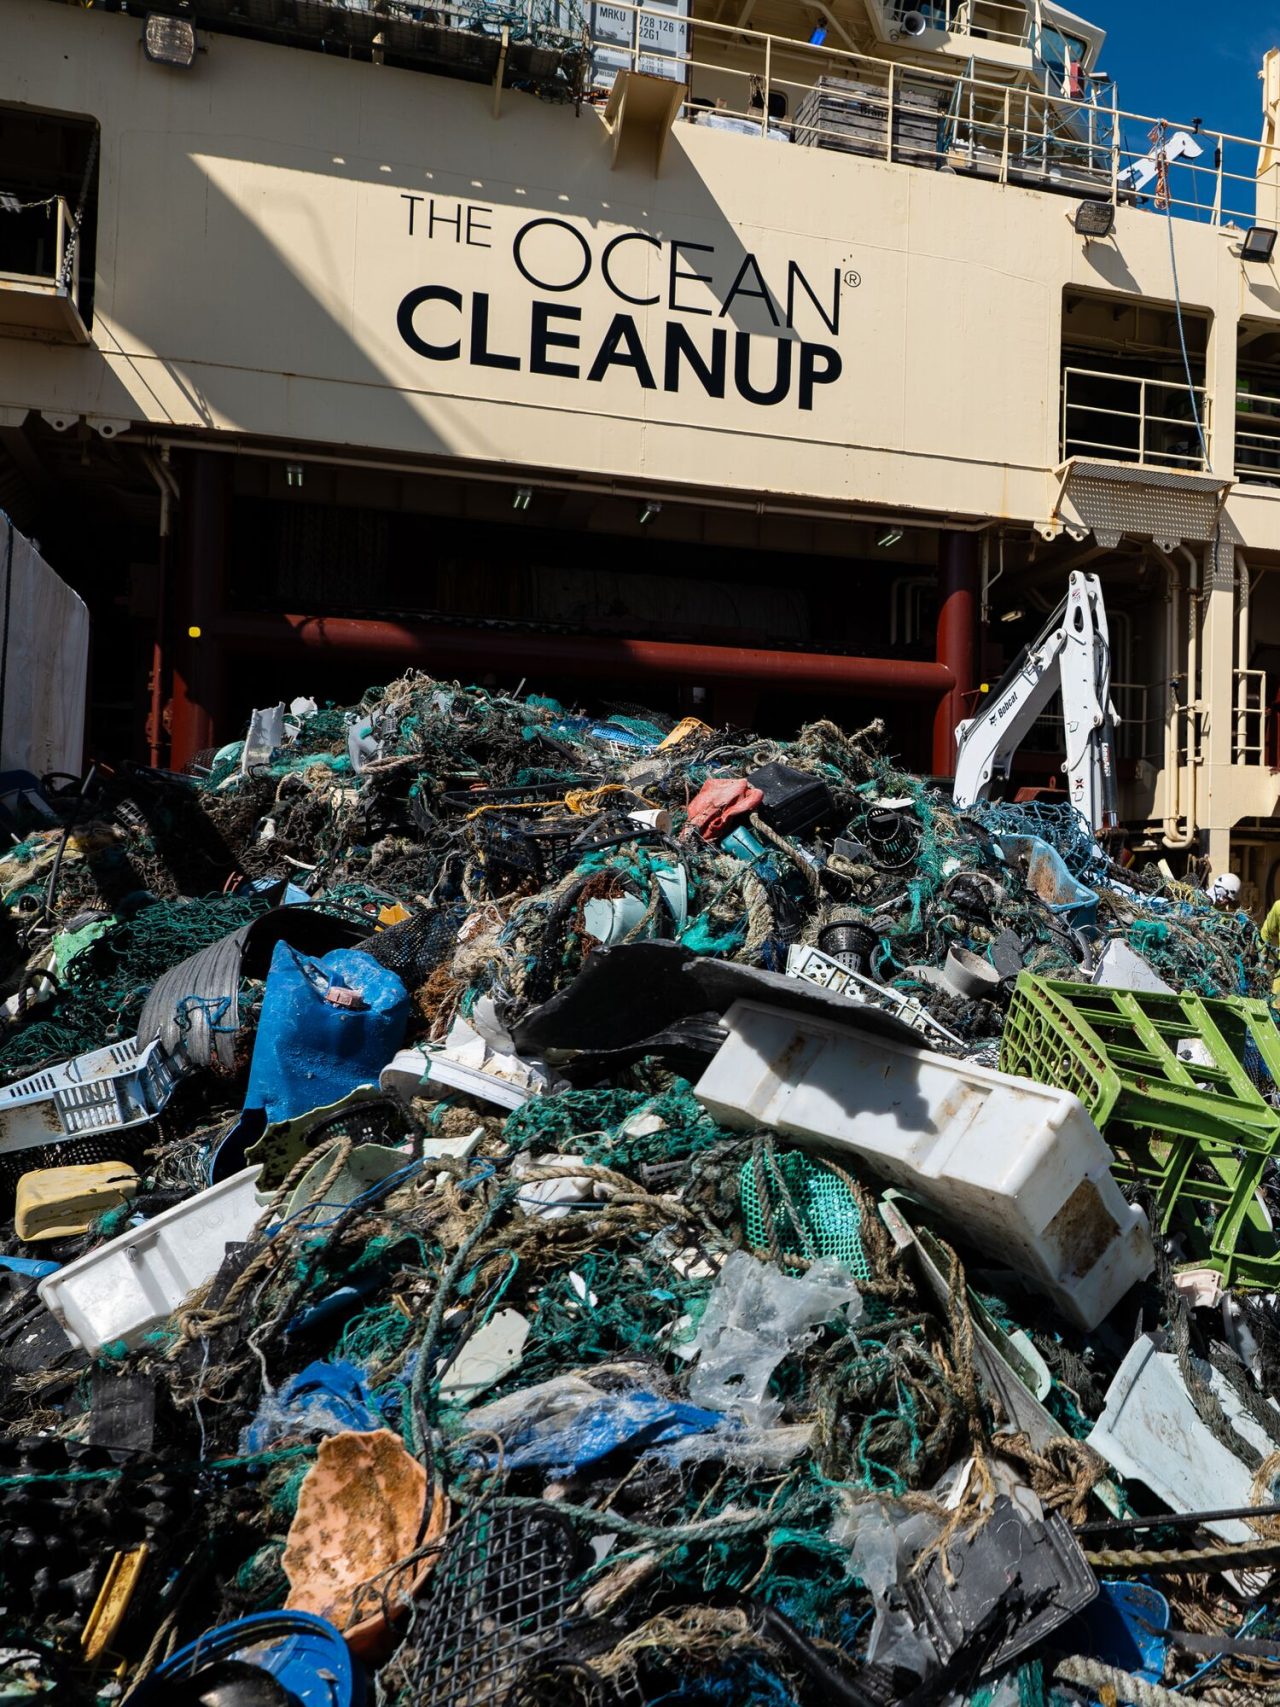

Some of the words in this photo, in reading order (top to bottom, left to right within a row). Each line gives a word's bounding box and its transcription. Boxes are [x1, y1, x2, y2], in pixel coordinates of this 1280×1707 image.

[599, 6, 626, 22] MRKU
[658, 20, 674, 32] 126
[679, 24, 685, 35] 4
[638, 26, 659, 40] 22G1
[400, 193, 493, 248] THE
[396, 284, 843, 411] CLEANUP
[997, 691, 1018, 718] Bobcat
